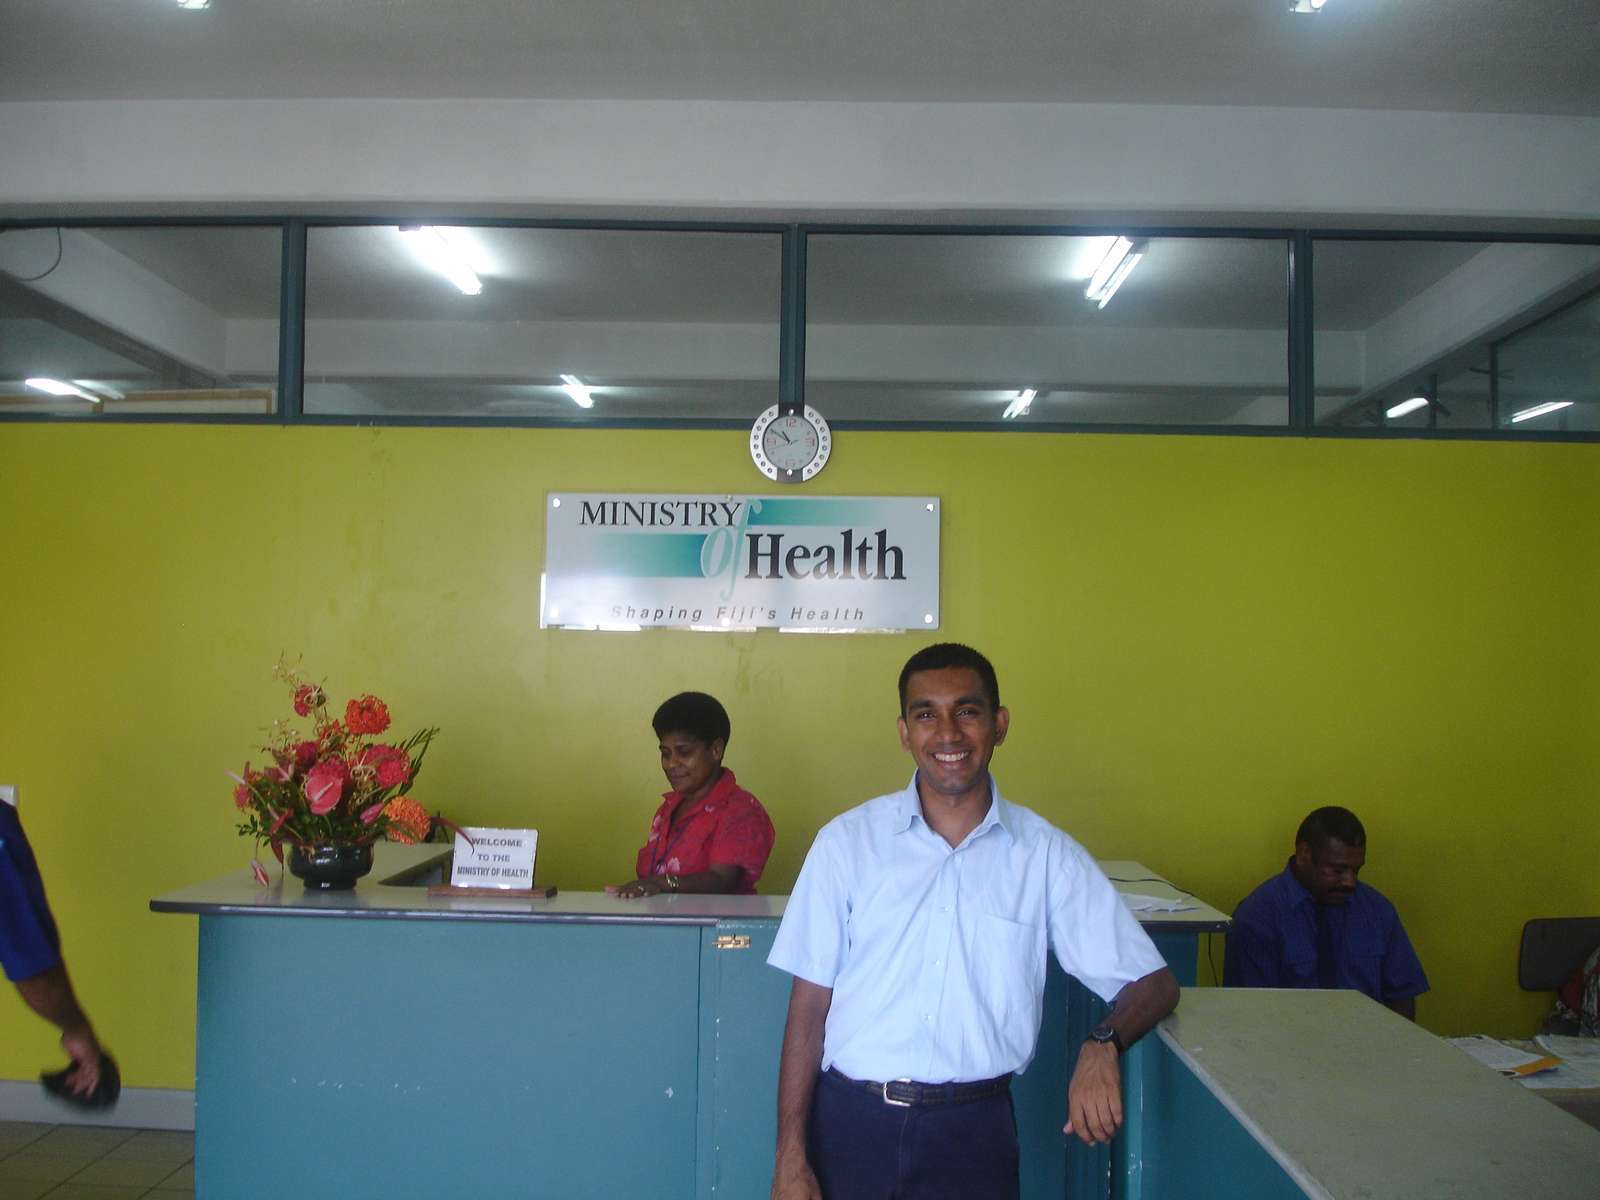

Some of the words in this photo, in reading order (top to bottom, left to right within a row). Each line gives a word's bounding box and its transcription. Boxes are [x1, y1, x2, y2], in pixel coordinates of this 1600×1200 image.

[578, 501, 742, 526] MINISTRY
[701, 497, 762, 601] of
[744, 529, 907, 580] Health
[611, 605, 702, 622] Shaping
[790, 607, 864, 620] Health
[472, 838, 523, 847] WELCOME
[478, 853, 490, 861] TO
[493, 854, 511, 862] THE
[457, 866, 490, 876] MINISTRY
[491, 867, 500, 876] OF
[501, 868, 529, 878] HEALTH
